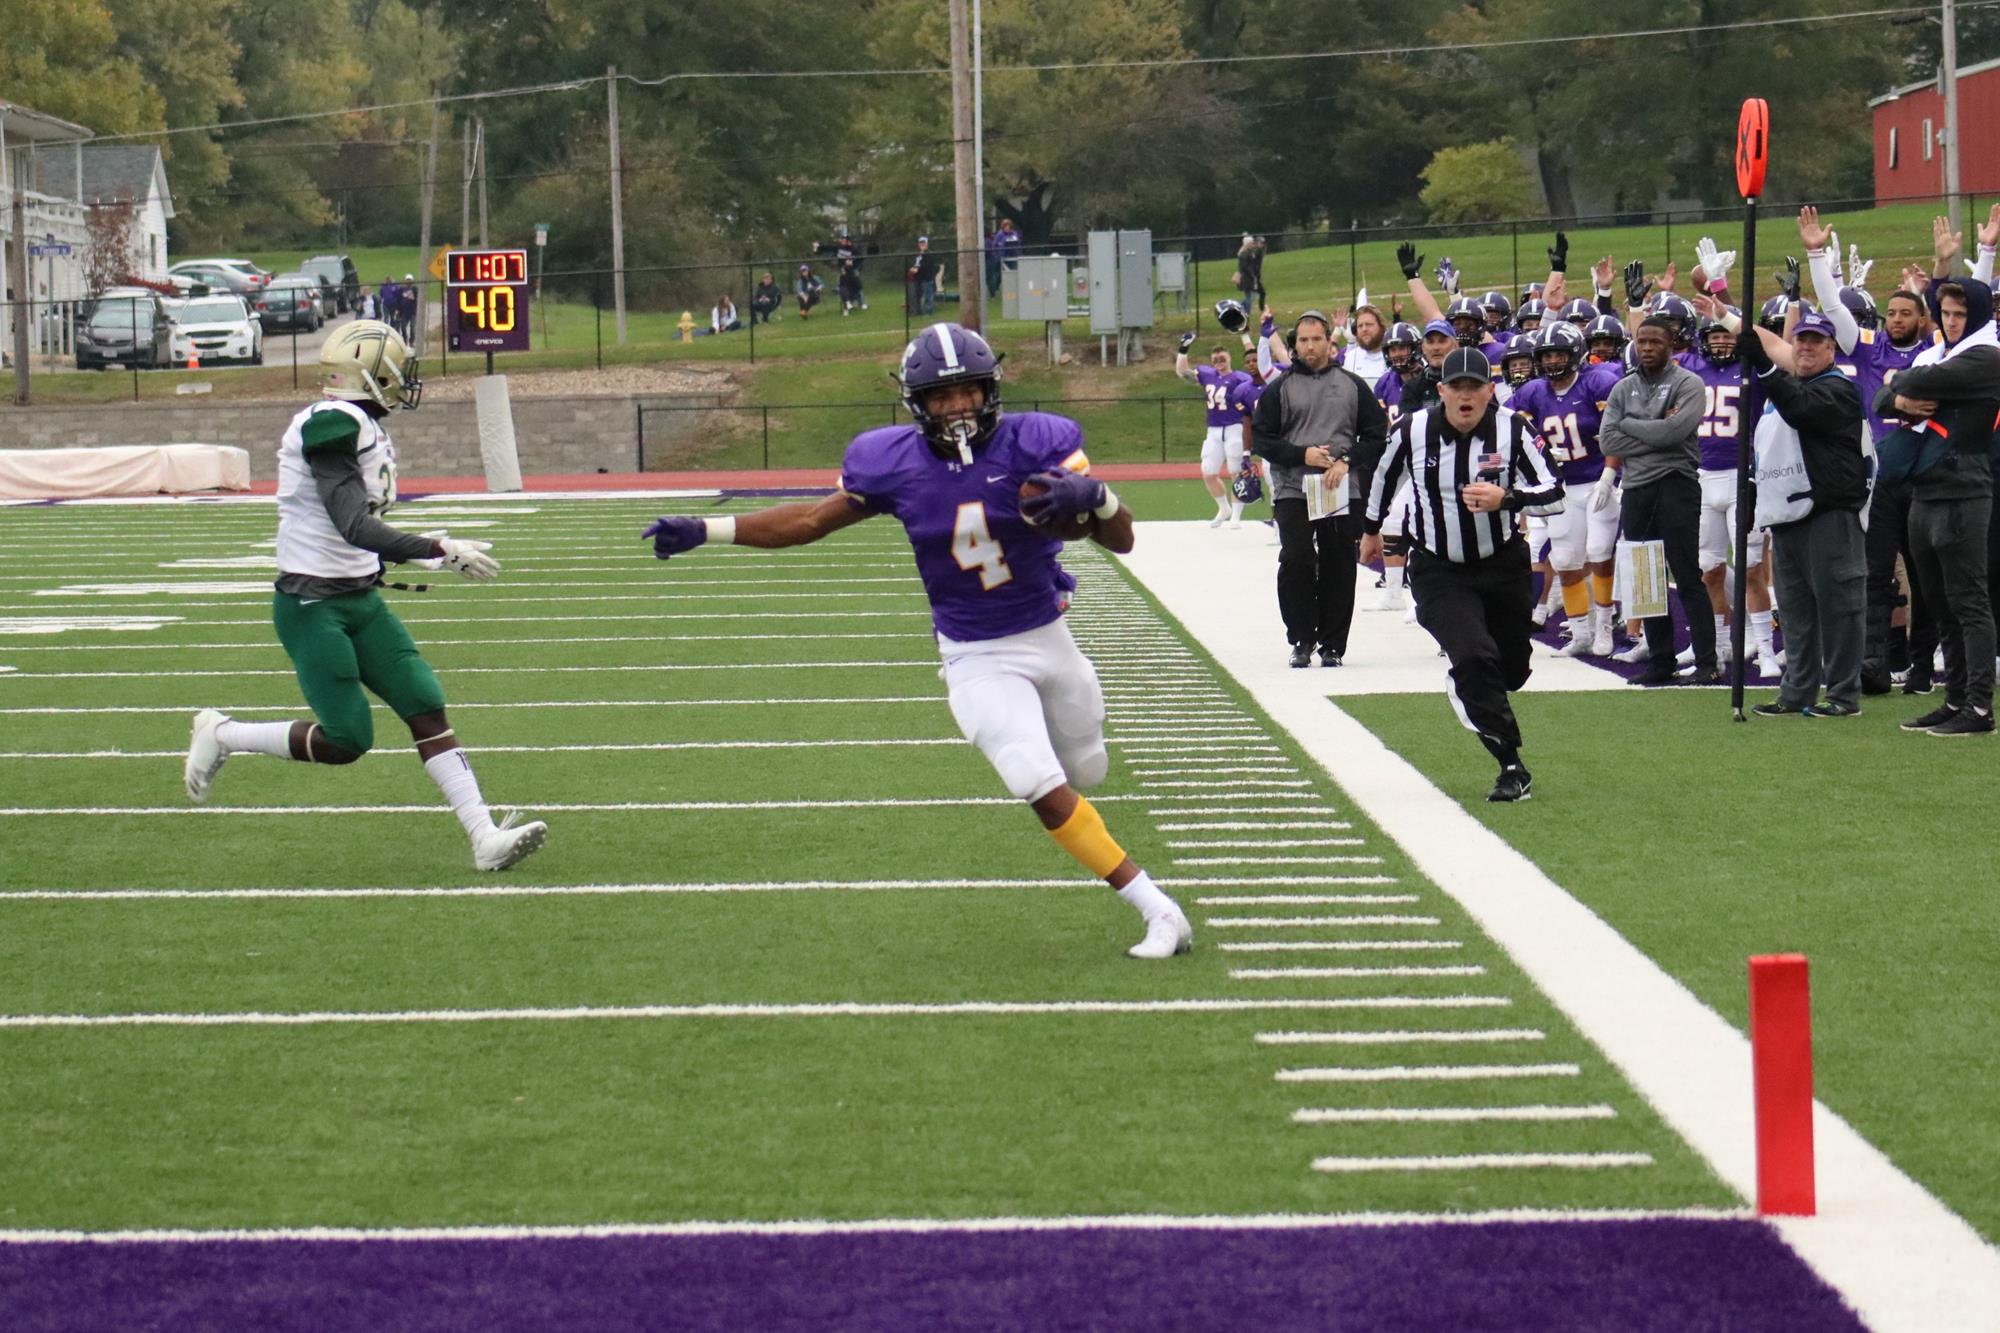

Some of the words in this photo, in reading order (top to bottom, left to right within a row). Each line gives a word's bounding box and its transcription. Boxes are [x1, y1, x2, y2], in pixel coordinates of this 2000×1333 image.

[457, 255, 524, 281] 11:07
[459, 286, 515, 332] 40
[1205, 383, 1228, 411] 34
[1697, 385, 1740, 437] 25
[1543, 412, 1589, 462] 21
[1760, 465, 1794, 481] Division
[952, 500, 1013, 591] 4
